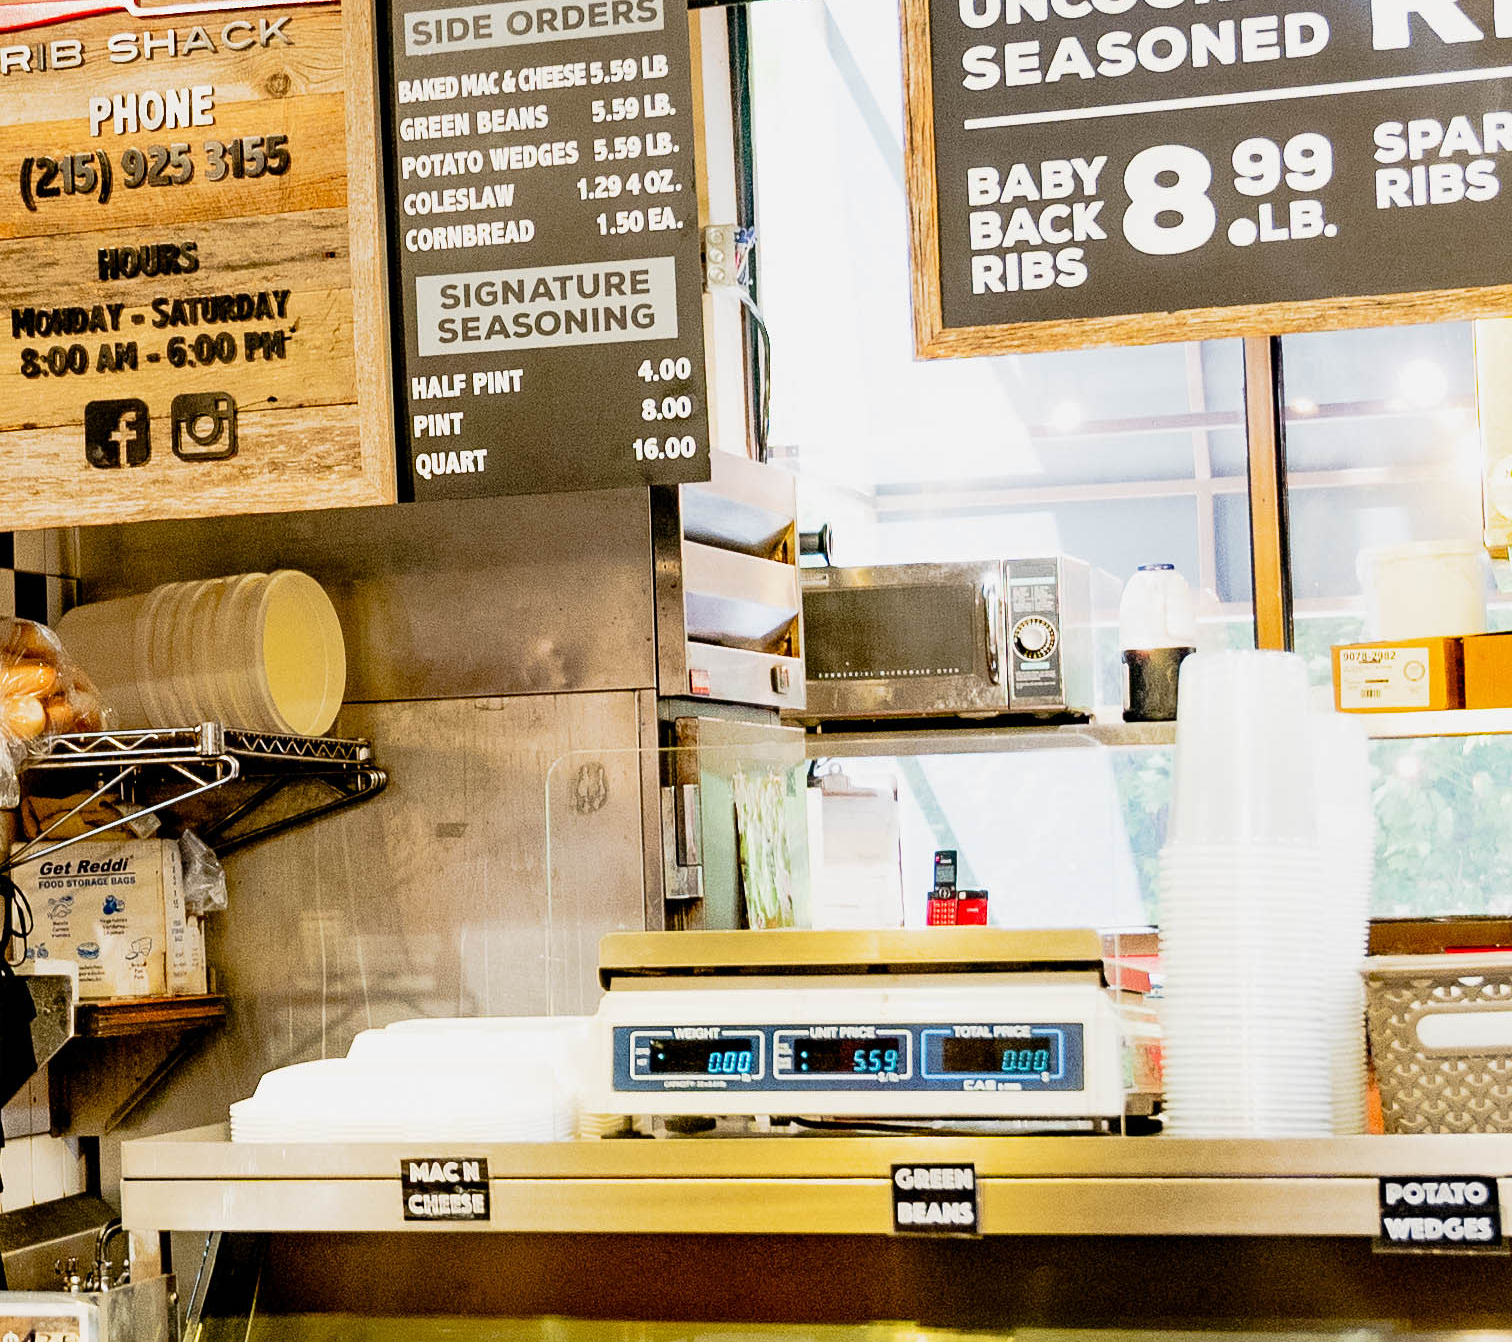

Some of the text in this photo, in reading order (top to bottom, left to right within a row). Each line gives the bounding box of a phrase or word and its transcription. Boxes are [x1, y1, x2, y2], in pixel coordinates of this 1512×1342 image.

[0, 17, 294, 75] RIB SHACK
[412, 15, 493, 46] SIDE
[961, 11, 1330, 91] SEASONED
[398, 55, 668, 103] BAKED MAC & CHEESE 5.59 LB
[89, 86, 216, 137] PHONE
[400, 92, 676, 141] GREEN BEANS 5.59 LB.
[20, 134, 291, 211] (215) 925 3155
[402, 130, 680, 179] POTATO WEDGES 5.59 LB.
[404, 170, 682, 215] COLESLAW 1.29 4 OZ.
[968, 132, 1333, 256] BABY 8 99
[1375, 158, 1500, 210] RIBS
[406, 207, 683, 252] CORNBREAD 1.50 EA.
[969, 200, 1106, 250] BACK
[97, 242, 200, 281] HOURS
[971, 248, 1088, 295] RIBS
[439, 270, 651, 310] SIGNATURE
[11, 290, 291, 339] MONDAY SATURDAY
[437, 307, 656, 344] SEASONING
[20, 330, 286, 379] 8:00 AM 6:00 PM
[411, 357, 691, 401] HALF PINT 4.00
[414, 396, 692, 438] PINT 8.00
[416, 436, 696, 478] QUART 16.00
[39, 876, 136, 888] FOOD STORAGE BAGS
[40, 858, 129, 875] Get Reddi
[674, 1025, 1032, 1040] WEIGHT UNIT PRICE TOTAL PRICE
[410, 1161, 479, 1184] MAC N
[895, 1168, 972, 1190] GREEN
[1386, 1182, 1488, 1205] POTATO
[408, 1191, 484, 1216] CHEESE
[897, 1203, 973, 1225] BEANS
[1384, 1217, 1495, 1241] WEDGES
